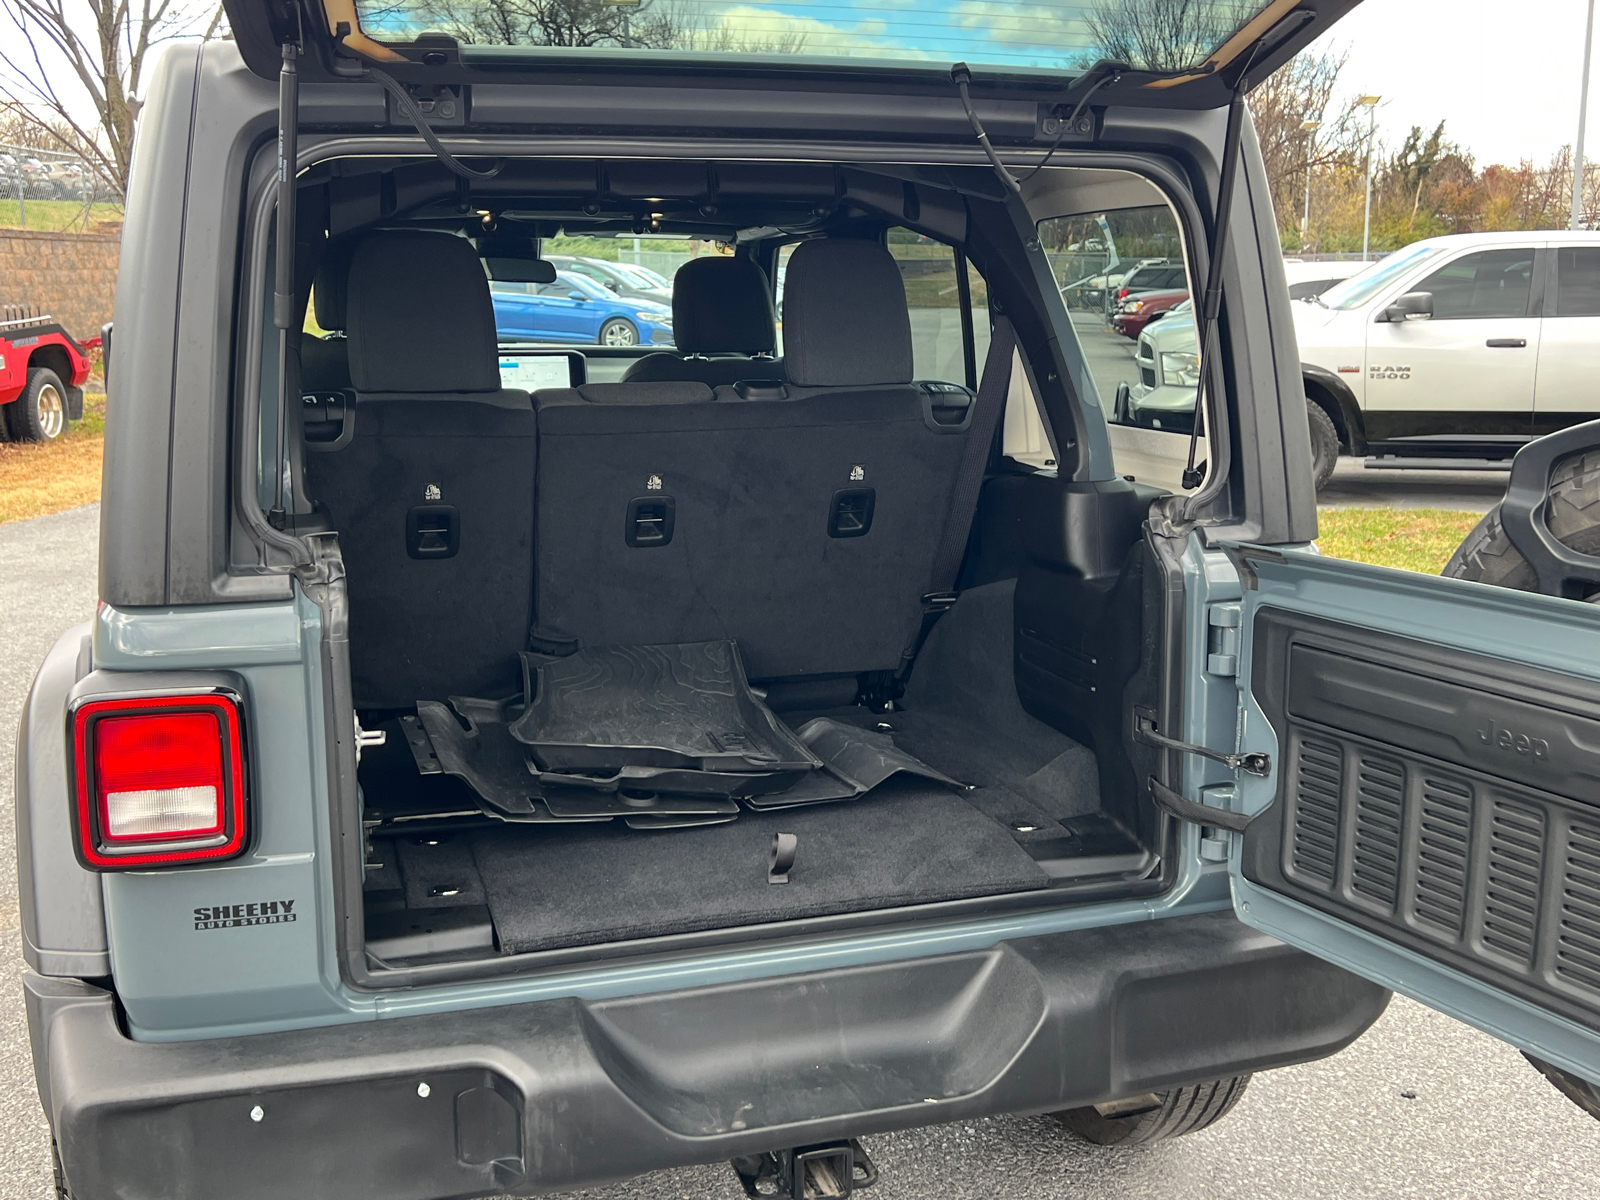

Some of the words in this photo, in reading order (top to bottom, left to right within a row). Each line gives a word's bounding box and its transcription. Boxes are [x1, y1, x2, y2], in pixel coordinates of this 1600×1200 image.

[1476, 719, 1550, 764] Jeep
[193, 900, 295, 921] SHEEHY
[197, 920, 234, 930] AUTO
[240, 914, 295, 926] STORES
